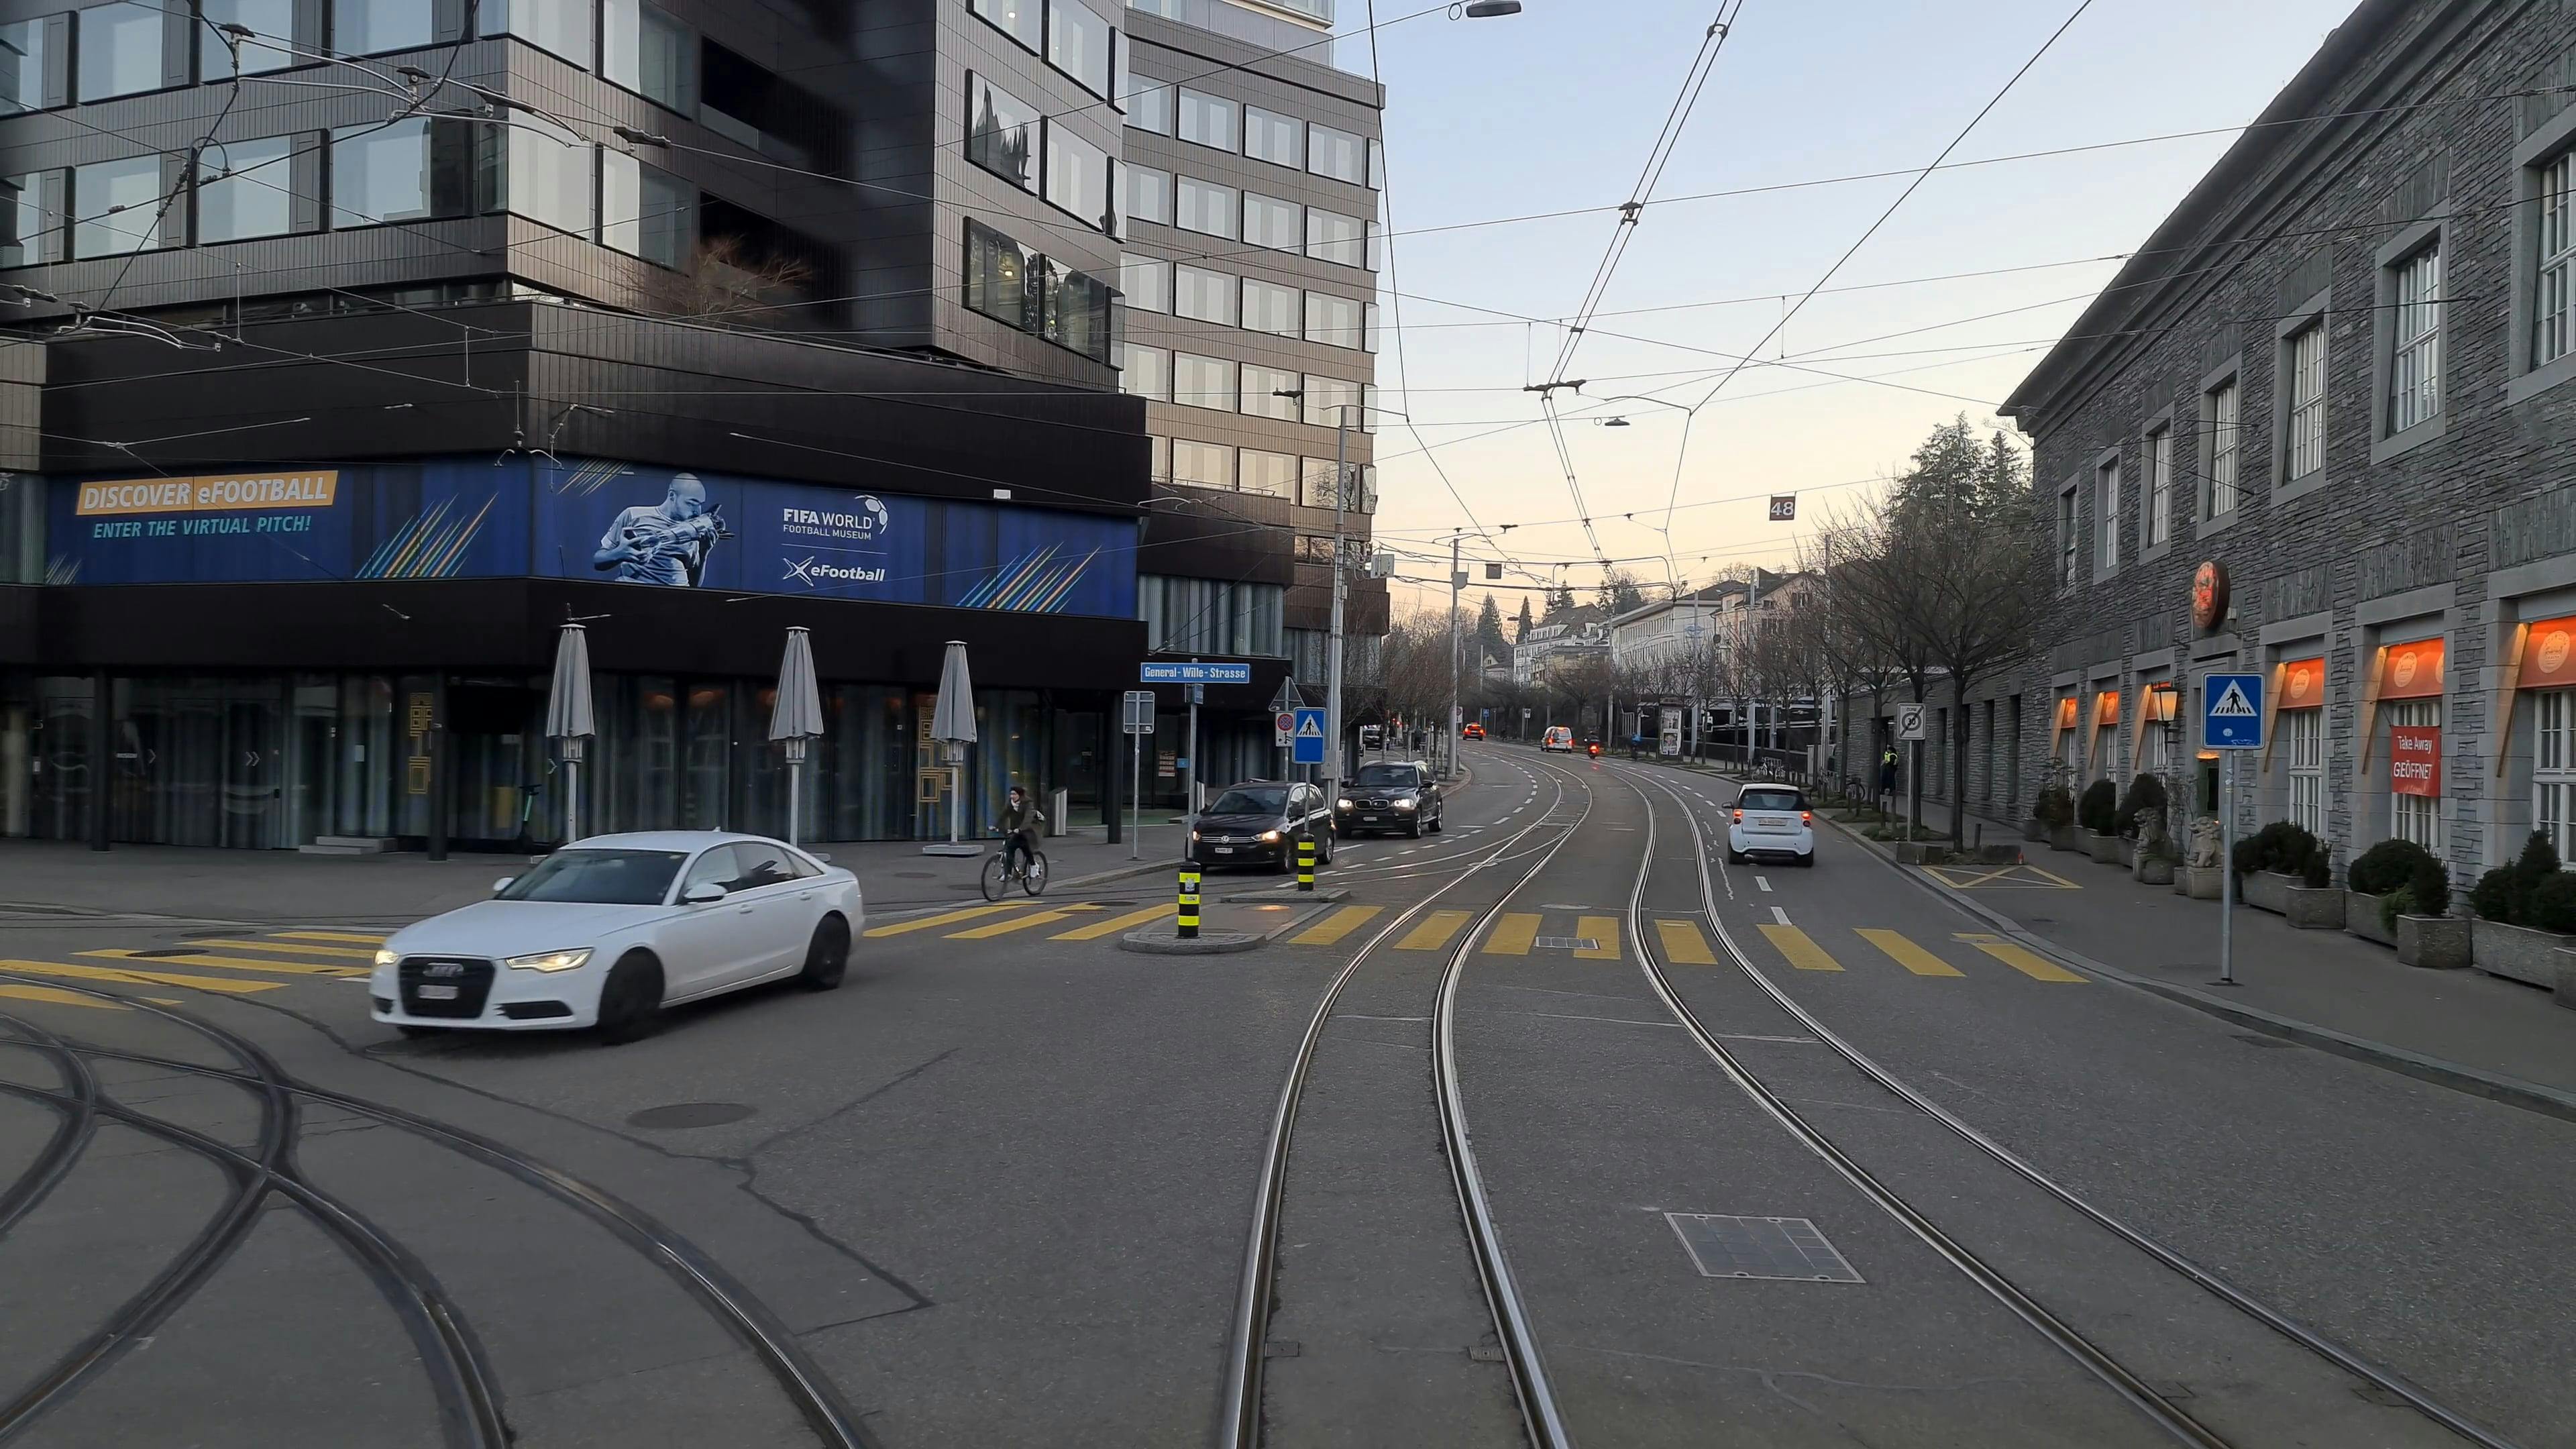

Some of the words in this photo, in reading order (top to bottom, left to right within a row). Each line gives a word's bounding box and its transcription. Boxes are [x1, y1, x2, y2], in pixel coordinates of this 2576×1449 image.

[84, 483, 191, 509] DISCOVER
[197, 477, 327, 504] eFOOTBALL
[1771, 502, 1793, 516] 48
[93, 522, 142, 539] ENTER
[148, 520, 176, 536] THE
[182, 518, 250, 535] VIRTUAL
[256, 515, 311, 533] PITCH!
[784, 508, 820, 525] FIFA
[822, 512, 872, 529] WORLD
[783, 525, 830, 537] FOOTBALL
[833, 529, 871, 540] MUSEUM
[810, 565, 885, 582] eFootball
[1907, 718, 1916, 726] 30
[2397, 735, 2413, 750] Take
[2414, 736, 2432, 755] Away
